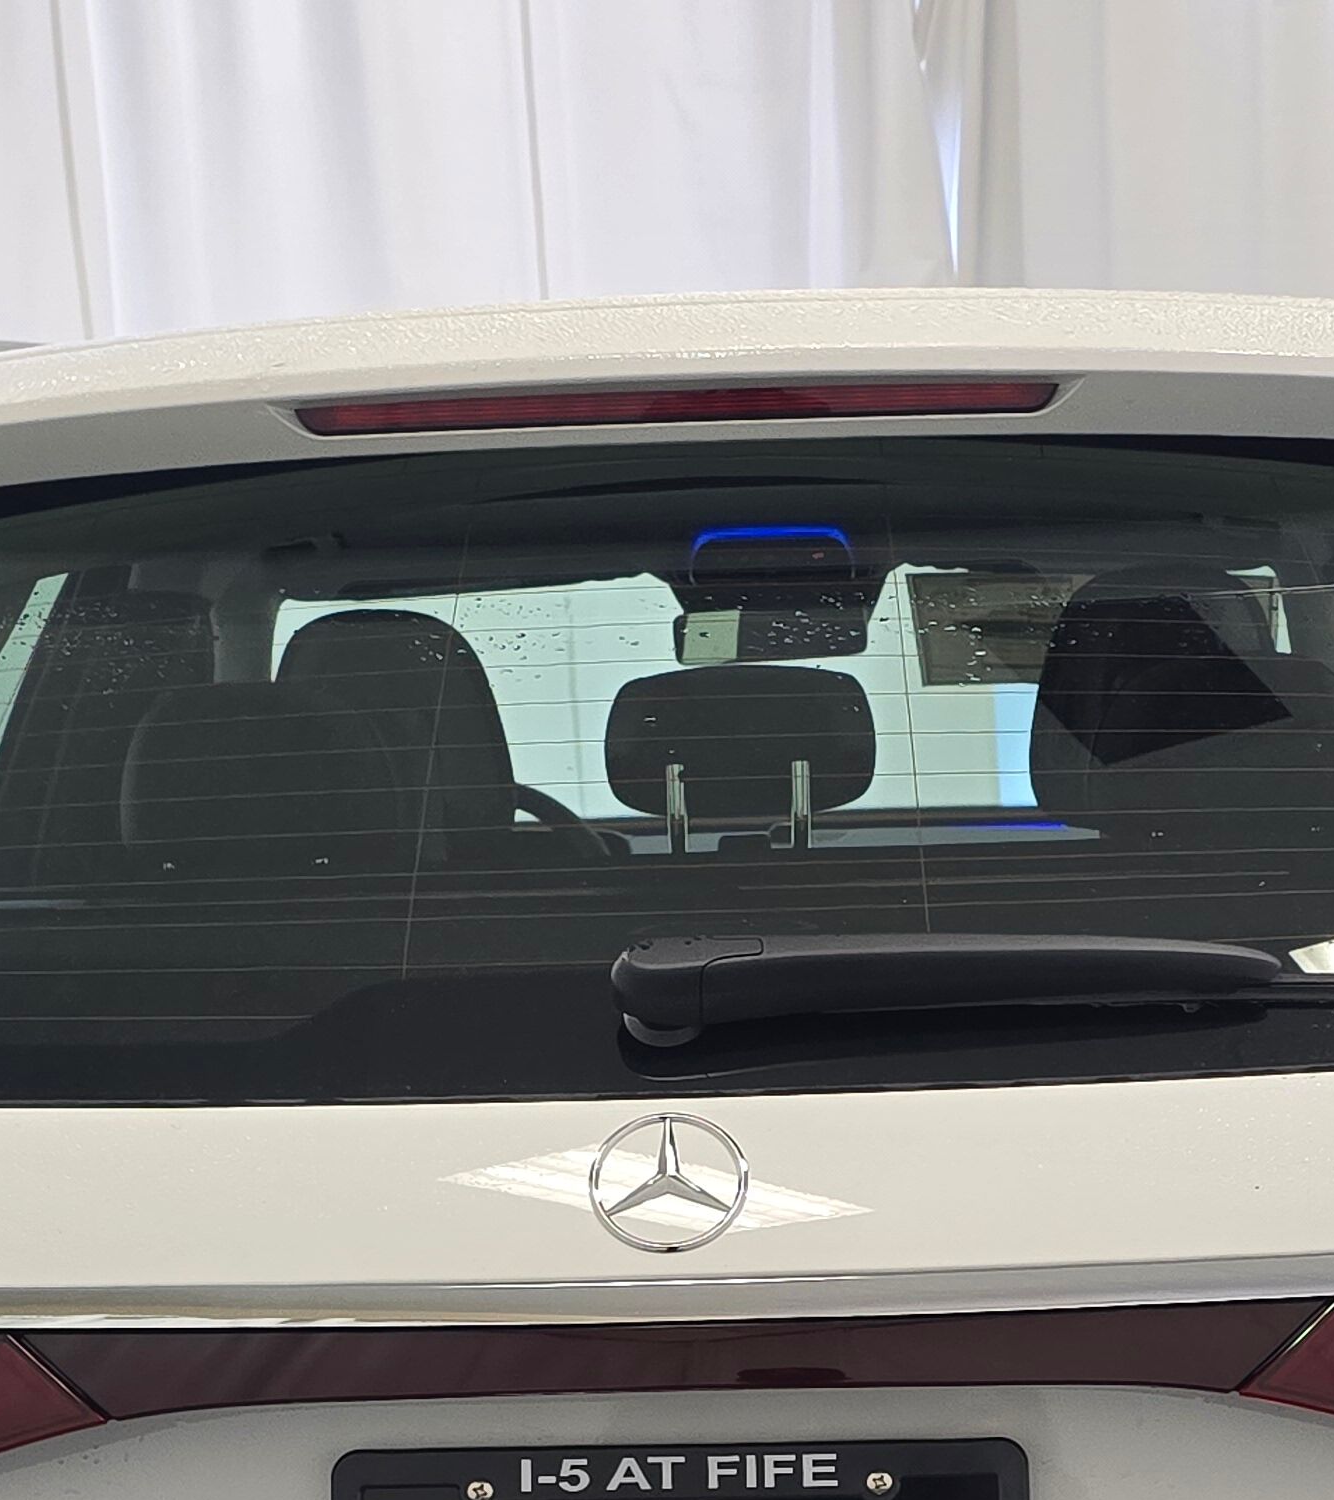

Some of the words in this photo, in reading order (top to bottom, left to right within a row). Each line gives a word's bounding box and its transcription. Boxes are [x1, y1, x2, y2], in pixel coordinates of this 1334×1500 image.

[520, 1458, 591, 1493] I-5
[606, 1456, 686, 1491] AT
[707, 1453, 839, 1490] FIFE
